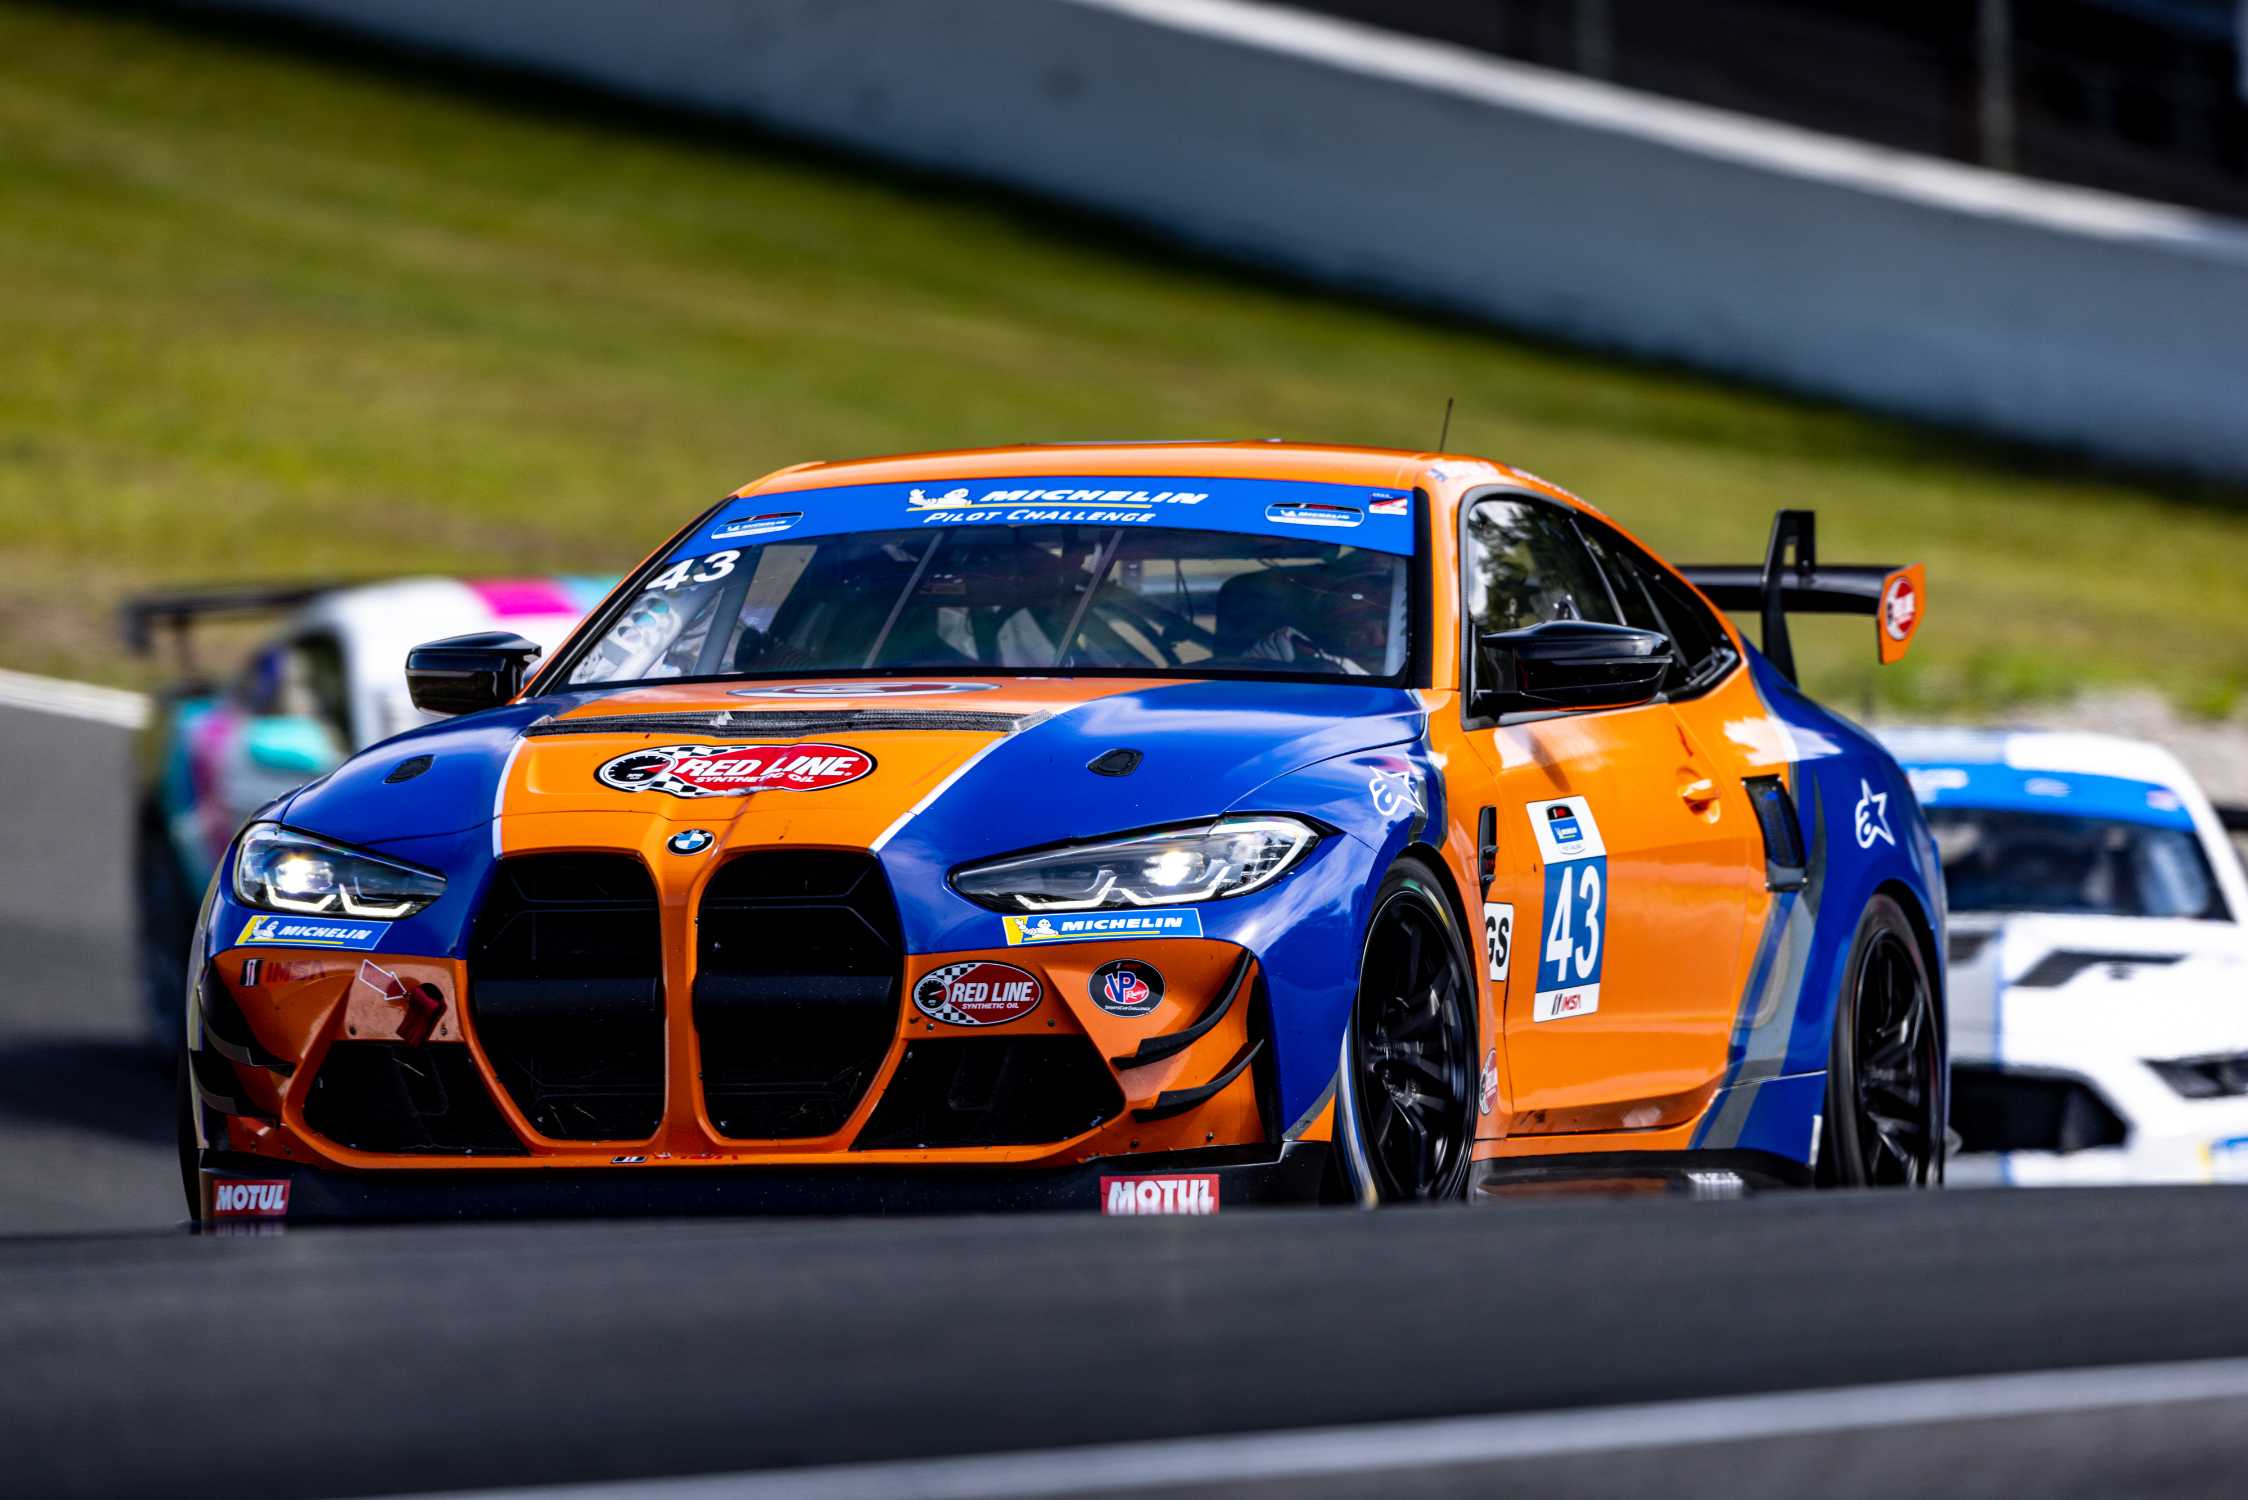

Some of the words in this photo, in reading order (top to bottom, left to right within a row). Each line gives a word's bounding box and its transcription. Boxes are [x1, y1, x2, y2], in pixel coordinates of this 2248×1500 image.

[979, 489, 1209, 505] MICHELIN
[923, 511, 1002, 524] PILOT
[1006, 509, 1156, 522] CHALLENGE
[645, 550, 741, 591] 43
[674, 758, 762, 777] RED
[763, 756, 859, 776] LINE
[788, 775, 815, 783] OIL
[278, 925, 373, 940] MICHELIN
[1061, 917, 1183, 931] MICHELIN
[1545, 862, 1600, 983] 43
[950, 982, 989, 1003] RED
[991, 981, 1034, 1003] LINE
[1105, 971, 1137, 1004] VP
[962, 1002, 1005, 1010] SYNTHETIC
[216, 1184, 286, 1211] MOTUL
[1107, 1179, 1214, 1215] MOTUL
